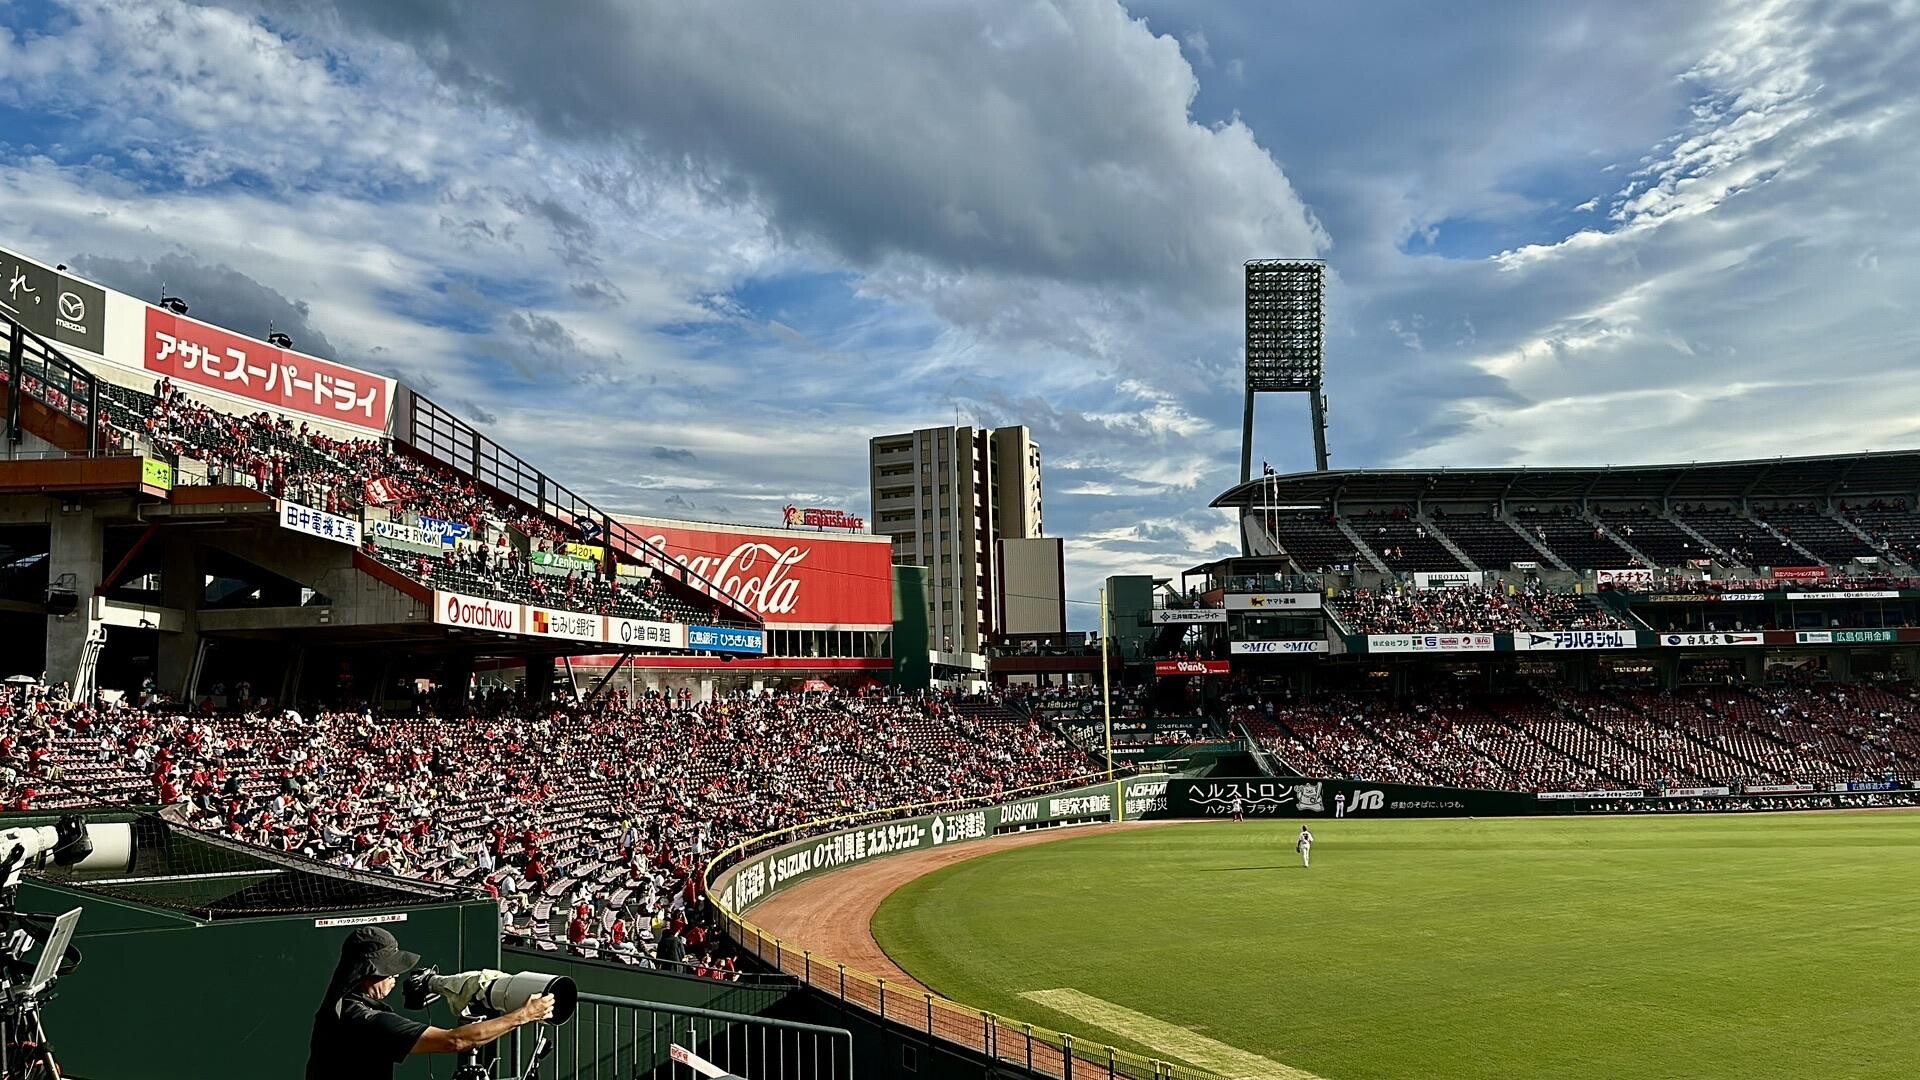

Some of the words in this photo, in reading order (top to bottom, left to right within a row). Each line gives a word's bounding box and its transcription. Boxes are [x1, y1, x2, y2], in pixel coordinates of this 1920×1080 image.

[55, 317, 87, 334] mazda
[287, 505, 357, 543] 田中電機工業
[806, 514, 864, 529] RENAISSANCE
[552, 554, 594, 571] Zenhoren
[1427, 573, 1469, 581] HIROTANI
[1615, 571, 1652, 582] チチヤス
[551, 615, 596, 638] もみじ銀行
[633, 625, 671, 643] 増岡組
[1249, 642, 1277, 653] MIC
[1290, 641, 1318, 652] MIC
[1177, 661, 1208, 674] Wants
[1188, 783, 1294, 799] ヘルストロン
[1125, 796, 1168, 814] 能美防災
[1346, 790, 1385, 812] JTB
[1000, 802, 1039, 824] DUSKIN
[946, 811, 986, 842] 五洋建設
[824, 830, 866, 869] 大和興産
[777, 849, 811, 882] SUZUKI
